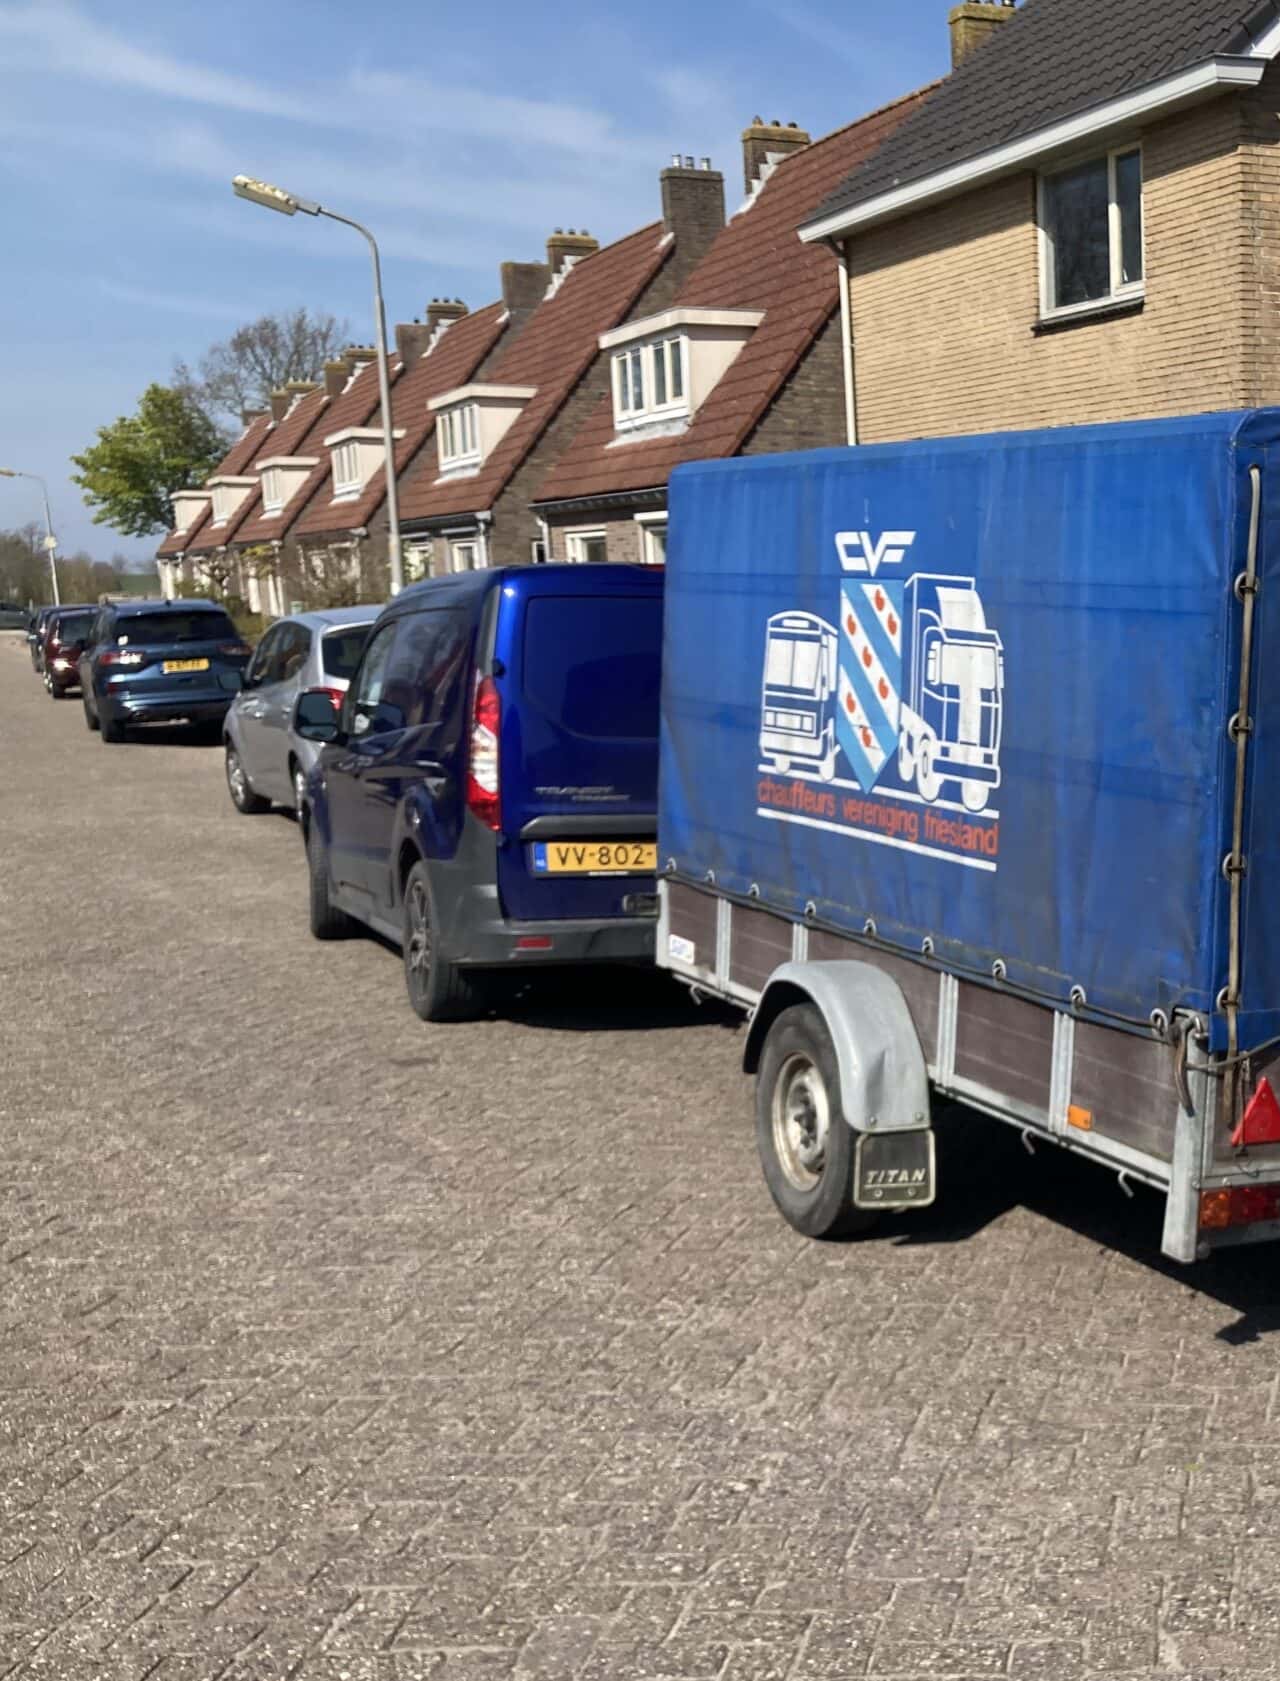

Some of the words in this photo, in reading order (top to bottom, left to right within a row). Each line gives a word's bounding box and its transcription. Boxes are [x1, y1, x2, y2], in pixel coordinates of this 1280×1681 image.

[835, 531, 917, 577] CVF
[757, 777, 836, 817] chauffeurs
[842, 797, 919, 843] vereniging
[924, 809, 999, 855] friesland
[867, 1168, 926, 1184] TITAN
